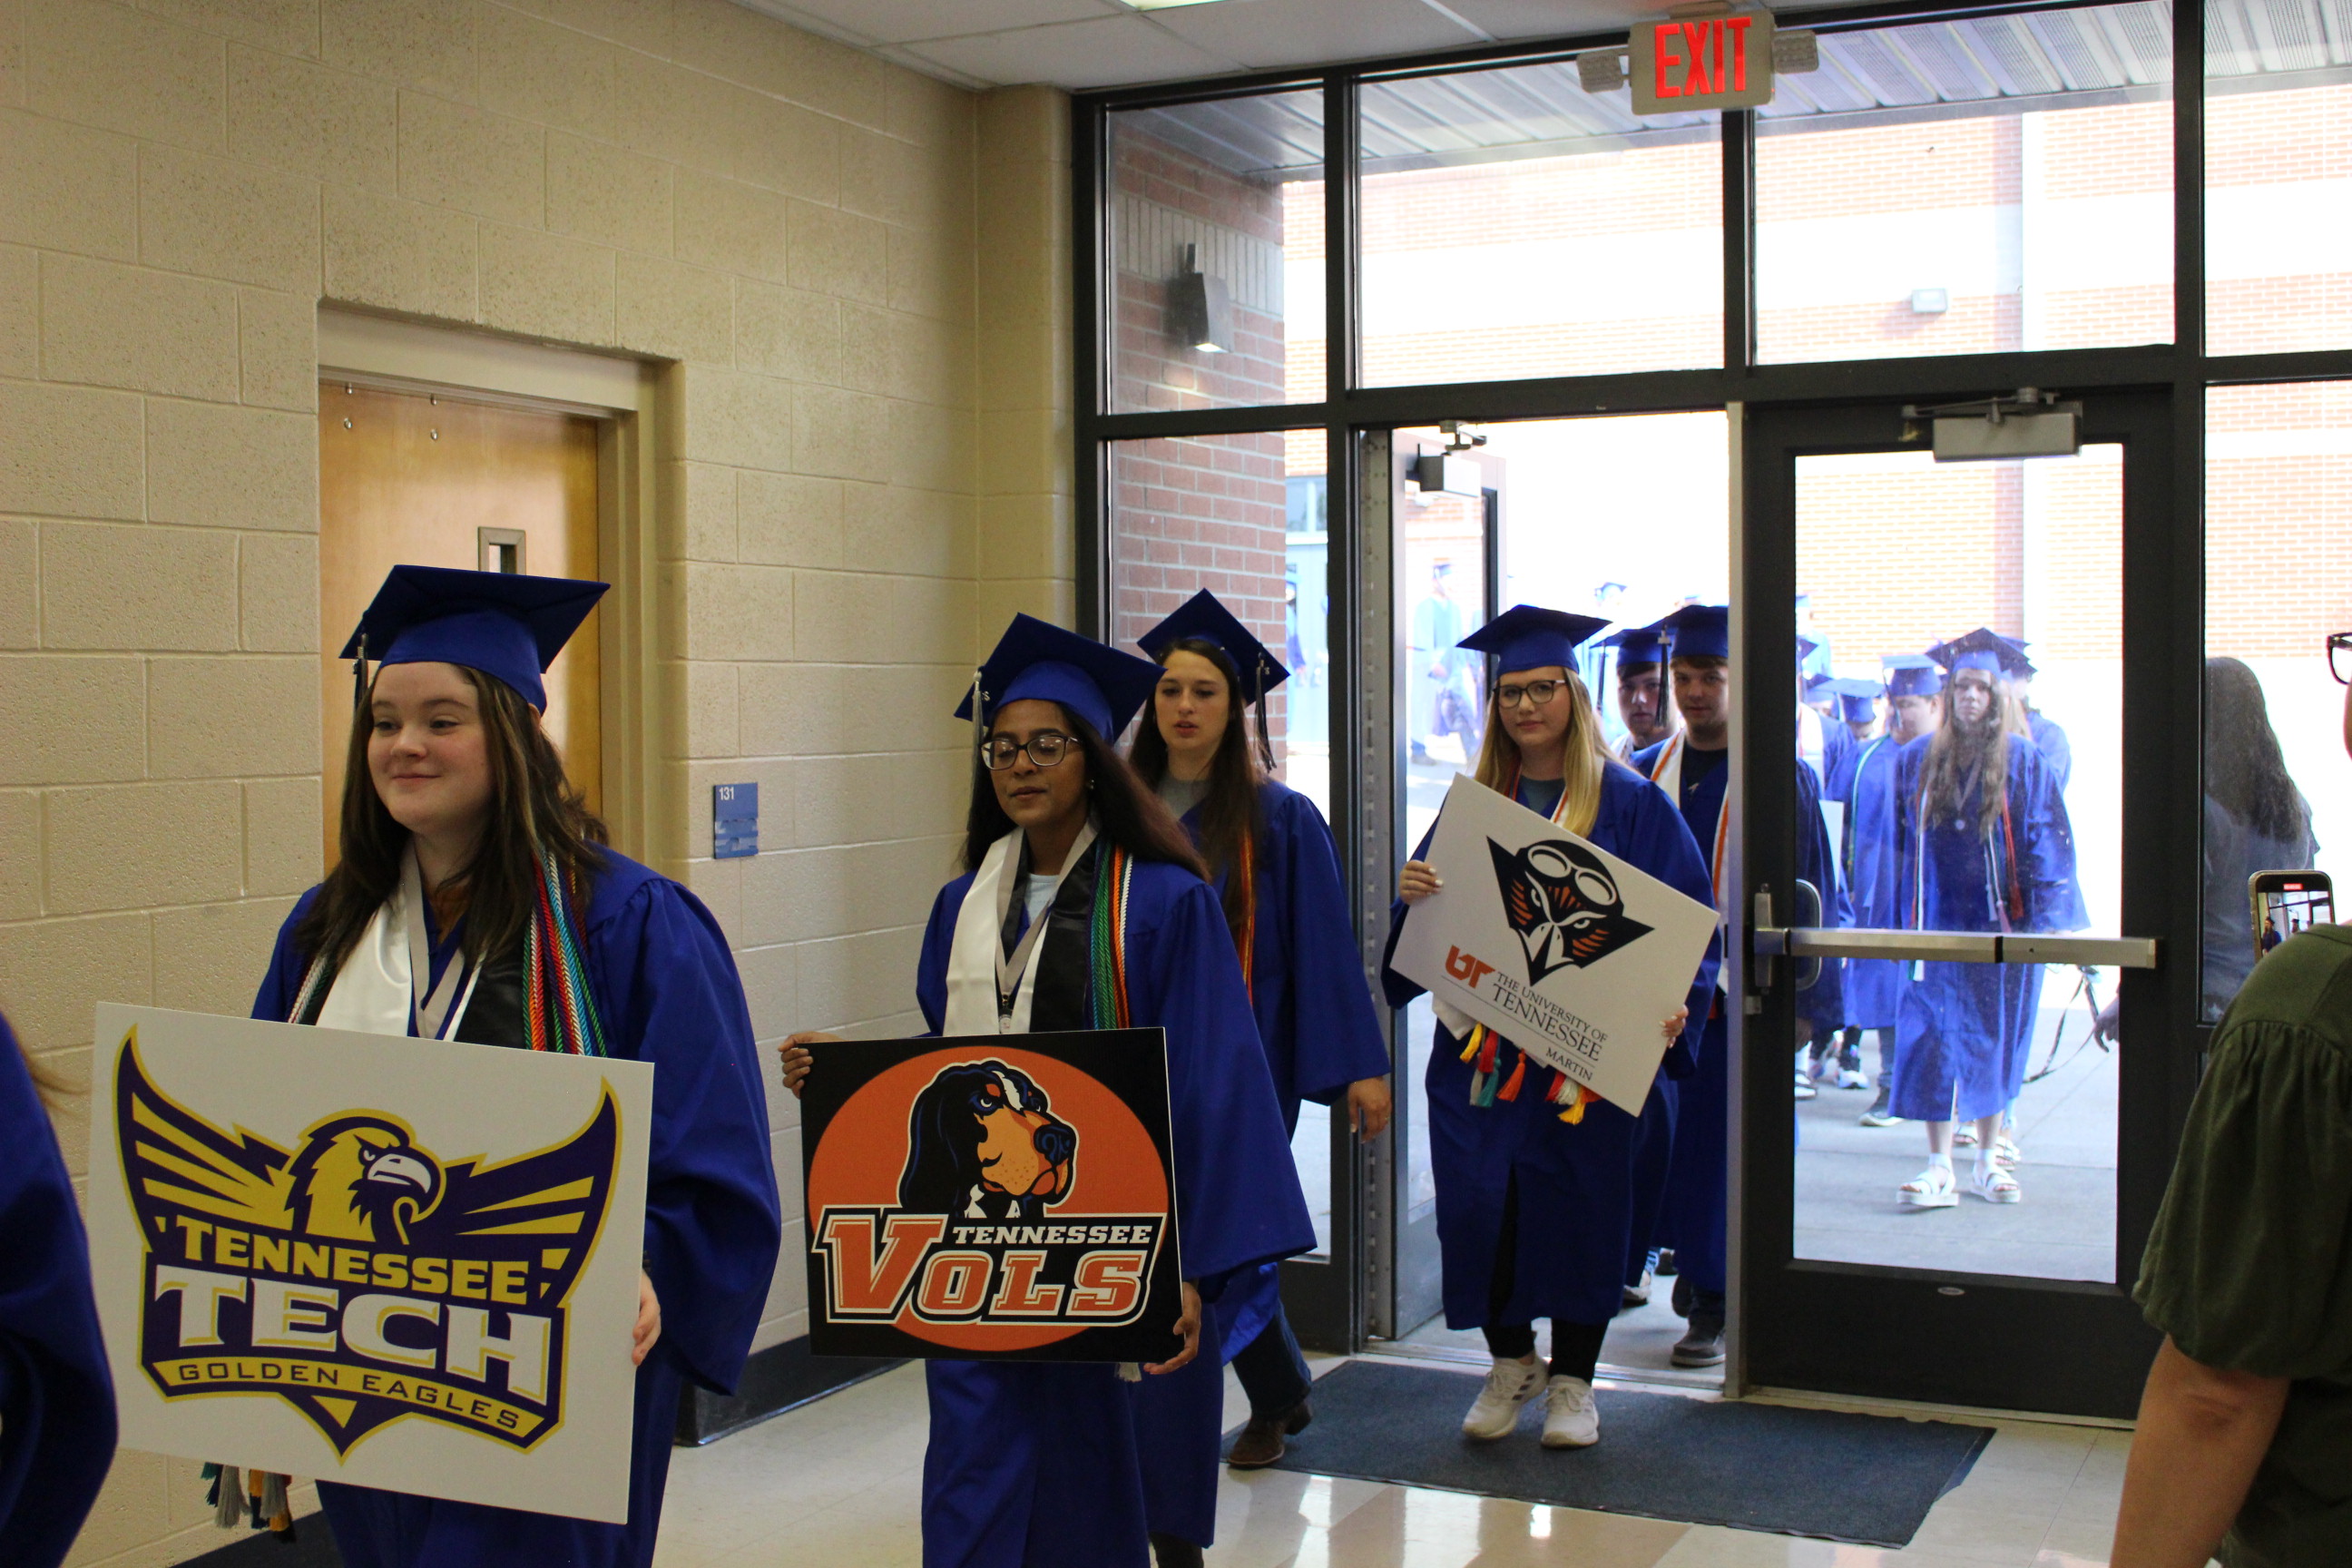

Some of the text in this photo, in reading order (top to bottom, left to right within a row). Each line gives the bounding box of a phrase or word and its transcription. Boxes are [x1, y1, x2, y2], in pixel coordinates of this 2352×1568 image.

[1654, 16, 1752, 99] EXIT
[719, 786, 735, 800] 131
[1445, 944, 1496, 989] UT
[1493, 983, 1602, 1062] TENNESSEE
[1497, 972, 1608, 1043] THE UNIVERSITY OF
[1546, 1047, 1593, 1082] MARTIN
[175, 1213, 529, 1306] TENNESSEE
[821, 1213, 1149, 1318] VOLS
[952, 1225, 1152, 1245] TENNESSEE
[153, 1263, 552, 1406] TECH
[178, 1360, 521, 1431] GOLDEN EAGLES
